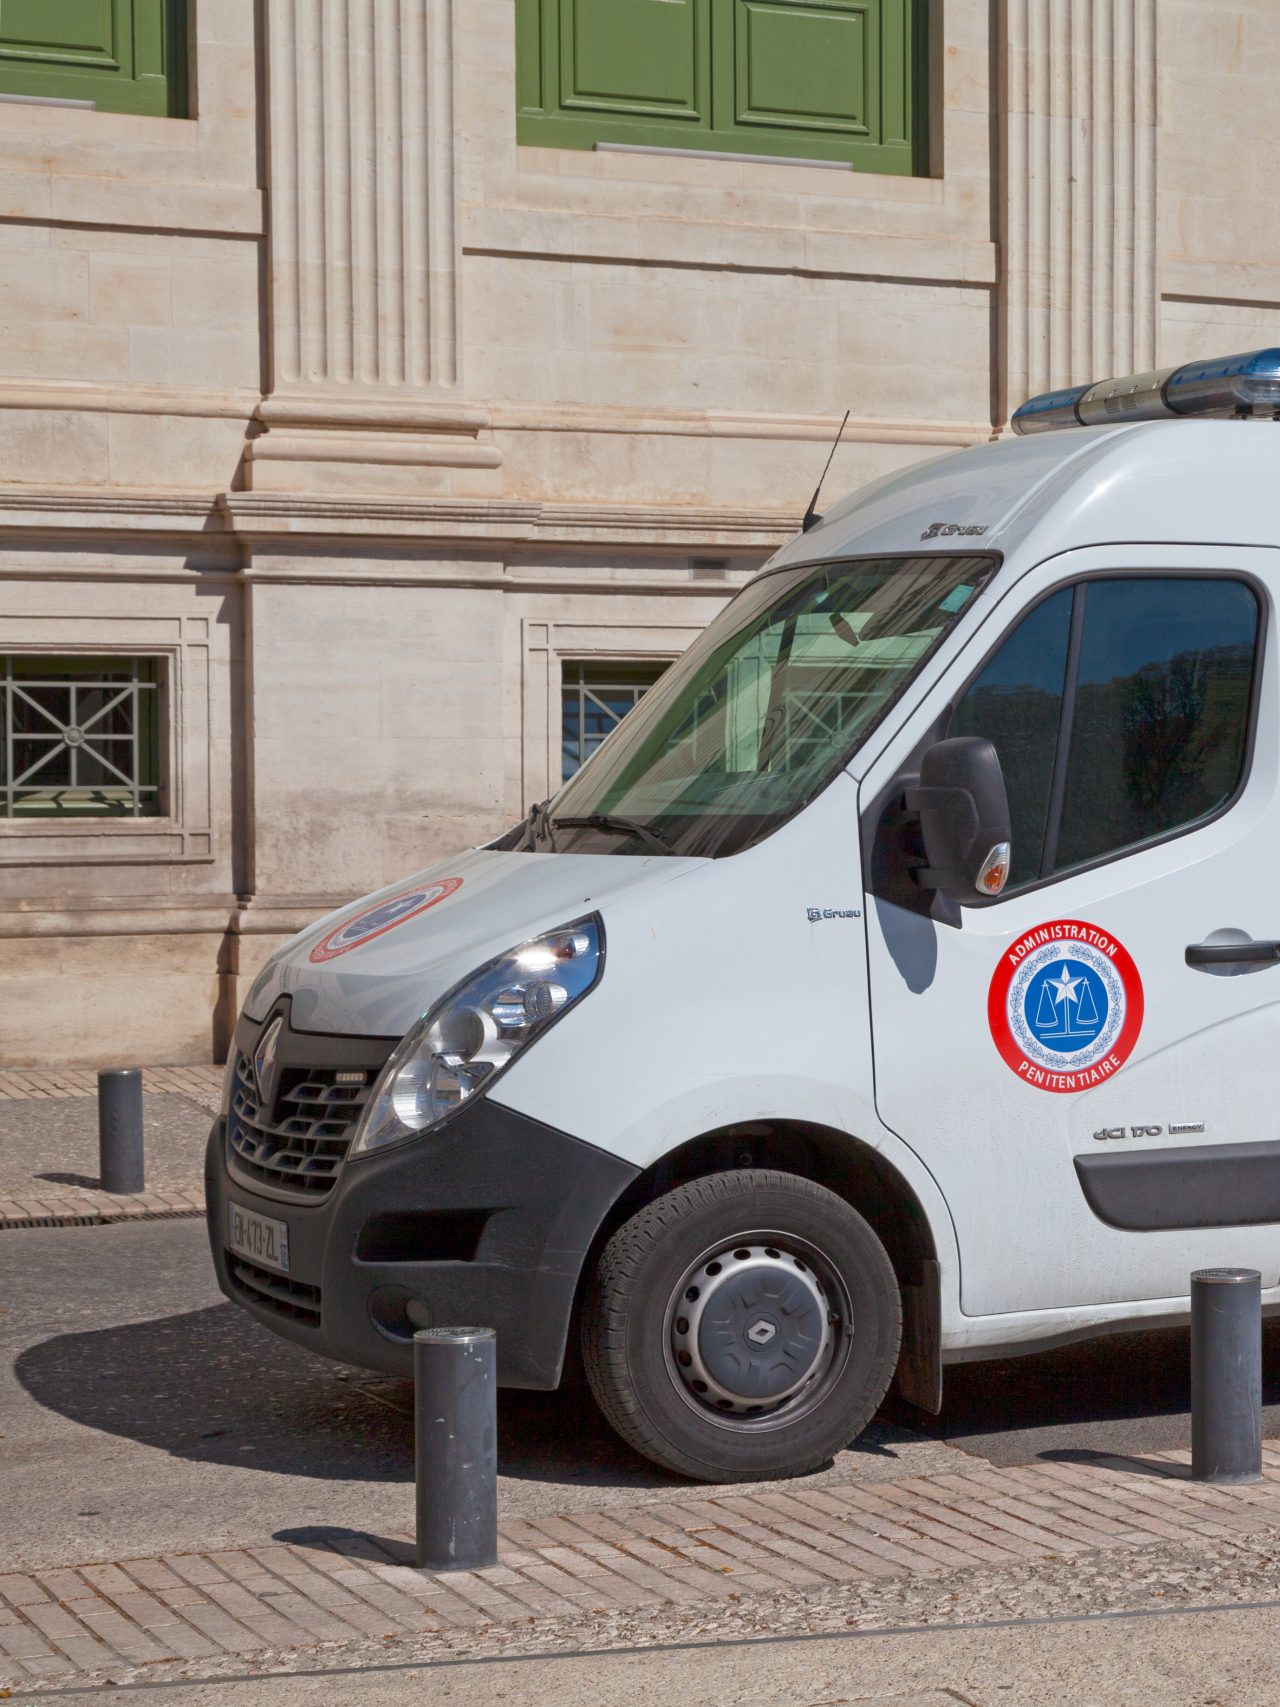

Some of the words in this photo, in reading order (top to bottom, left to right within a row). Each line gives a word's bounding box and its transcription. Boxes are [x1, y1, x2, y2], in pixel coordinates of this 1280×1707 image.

[822, 908, 861, 919] Gruau
[1008, 924, 1119, 966] ADMINISTRATION
[1017, 1053, 1121, 1089] PENITENTIAIRE
[1131, 1125, 1163, 1138] 170
